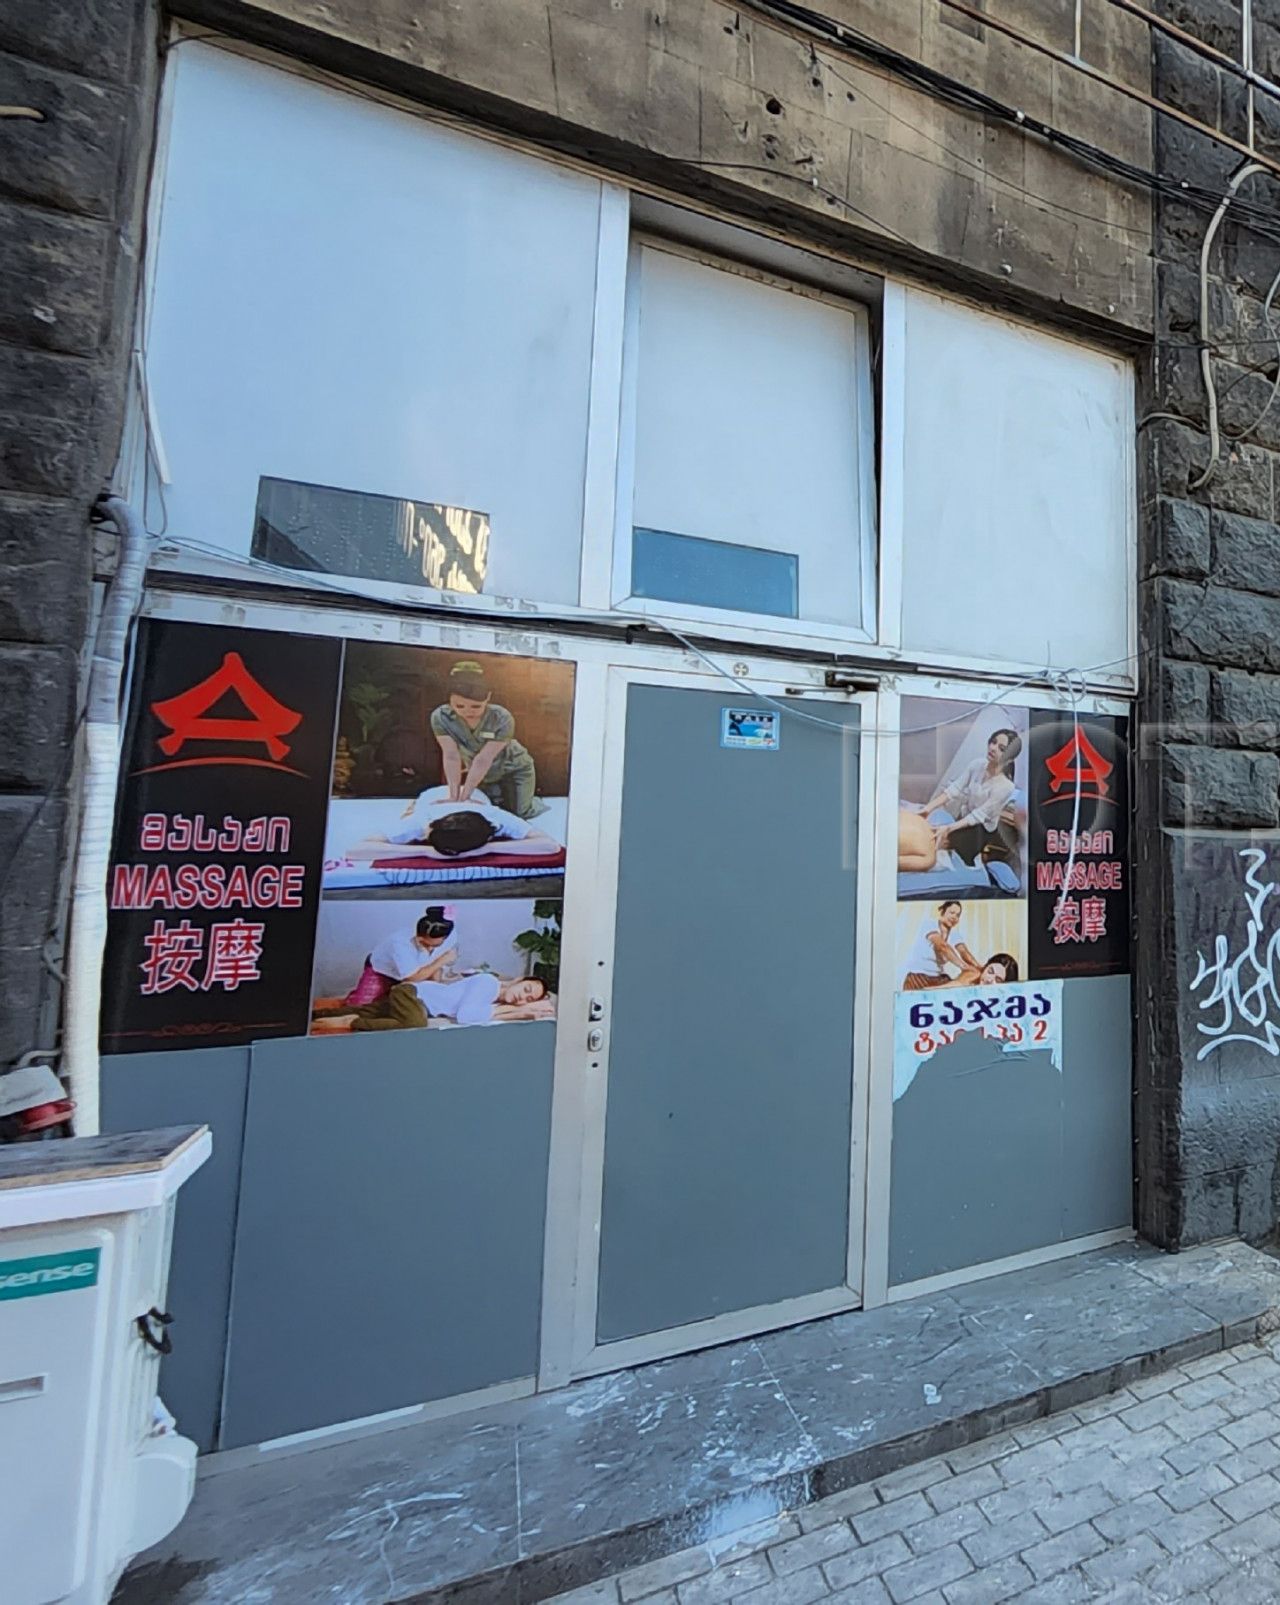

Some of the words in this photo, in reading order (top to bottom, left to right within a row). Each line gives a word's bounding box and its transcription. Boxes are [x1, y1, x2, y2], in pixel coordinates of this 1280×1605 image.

[141, 813, 290, 852] მასაჟი
[110, 864, 305, 909] MASSAGE
[1036, 861, 1122, 890] MASSAGE
[1050, 895, 1106, 944] 按摩
[140, 918, 265, 995] 按摩
[910, 993, 1051, 1028] ნაჯმა
[1034, 1020, 1048, 1041] 2
